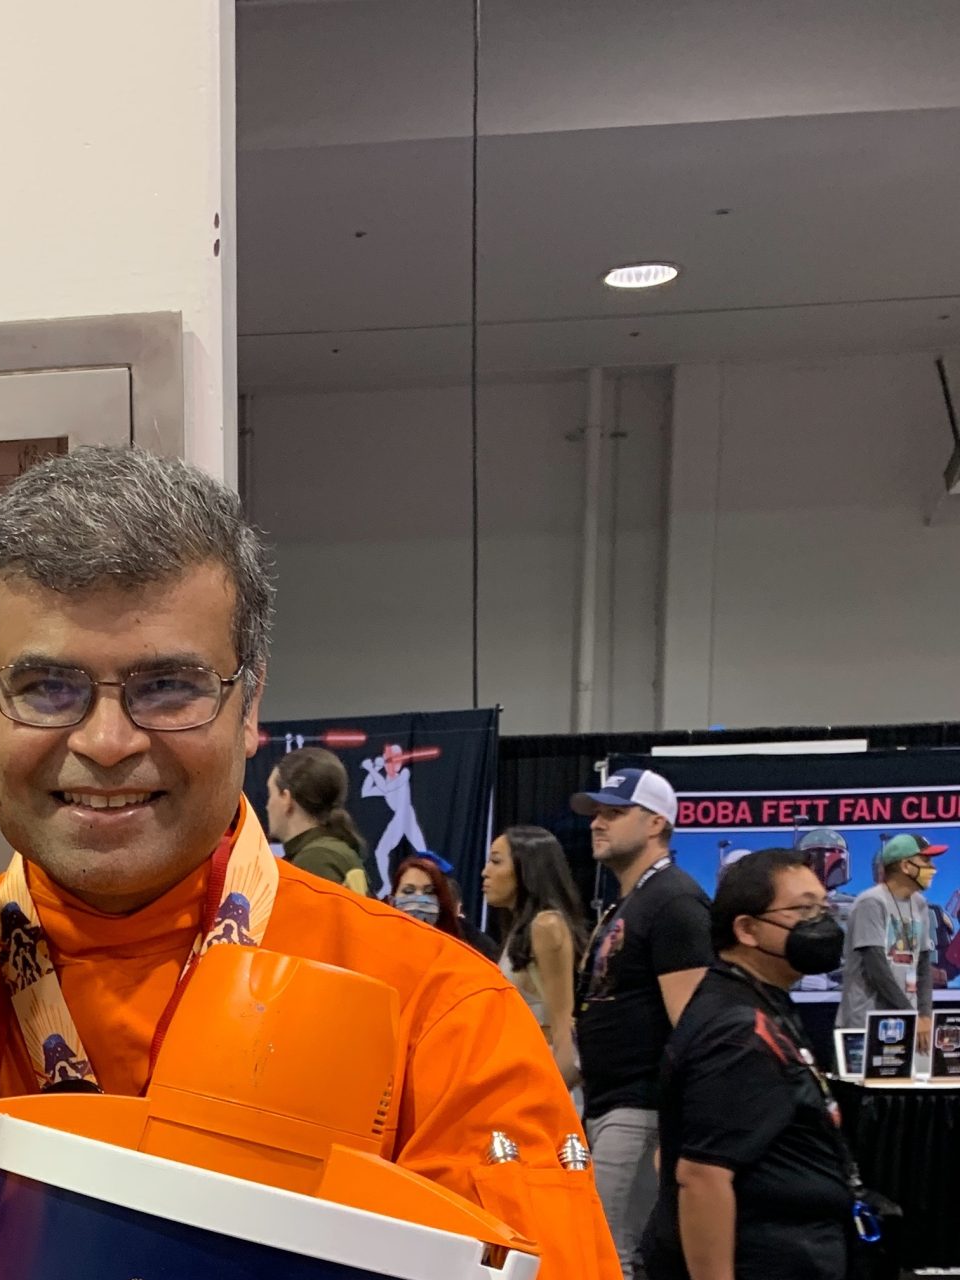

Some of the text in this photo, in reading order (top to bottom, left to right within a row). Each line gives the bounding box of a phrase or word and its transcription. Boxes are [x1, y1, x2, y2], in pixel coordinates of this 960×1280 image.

[678, 795, 960, 824] BOBA FETT FAN CLU
